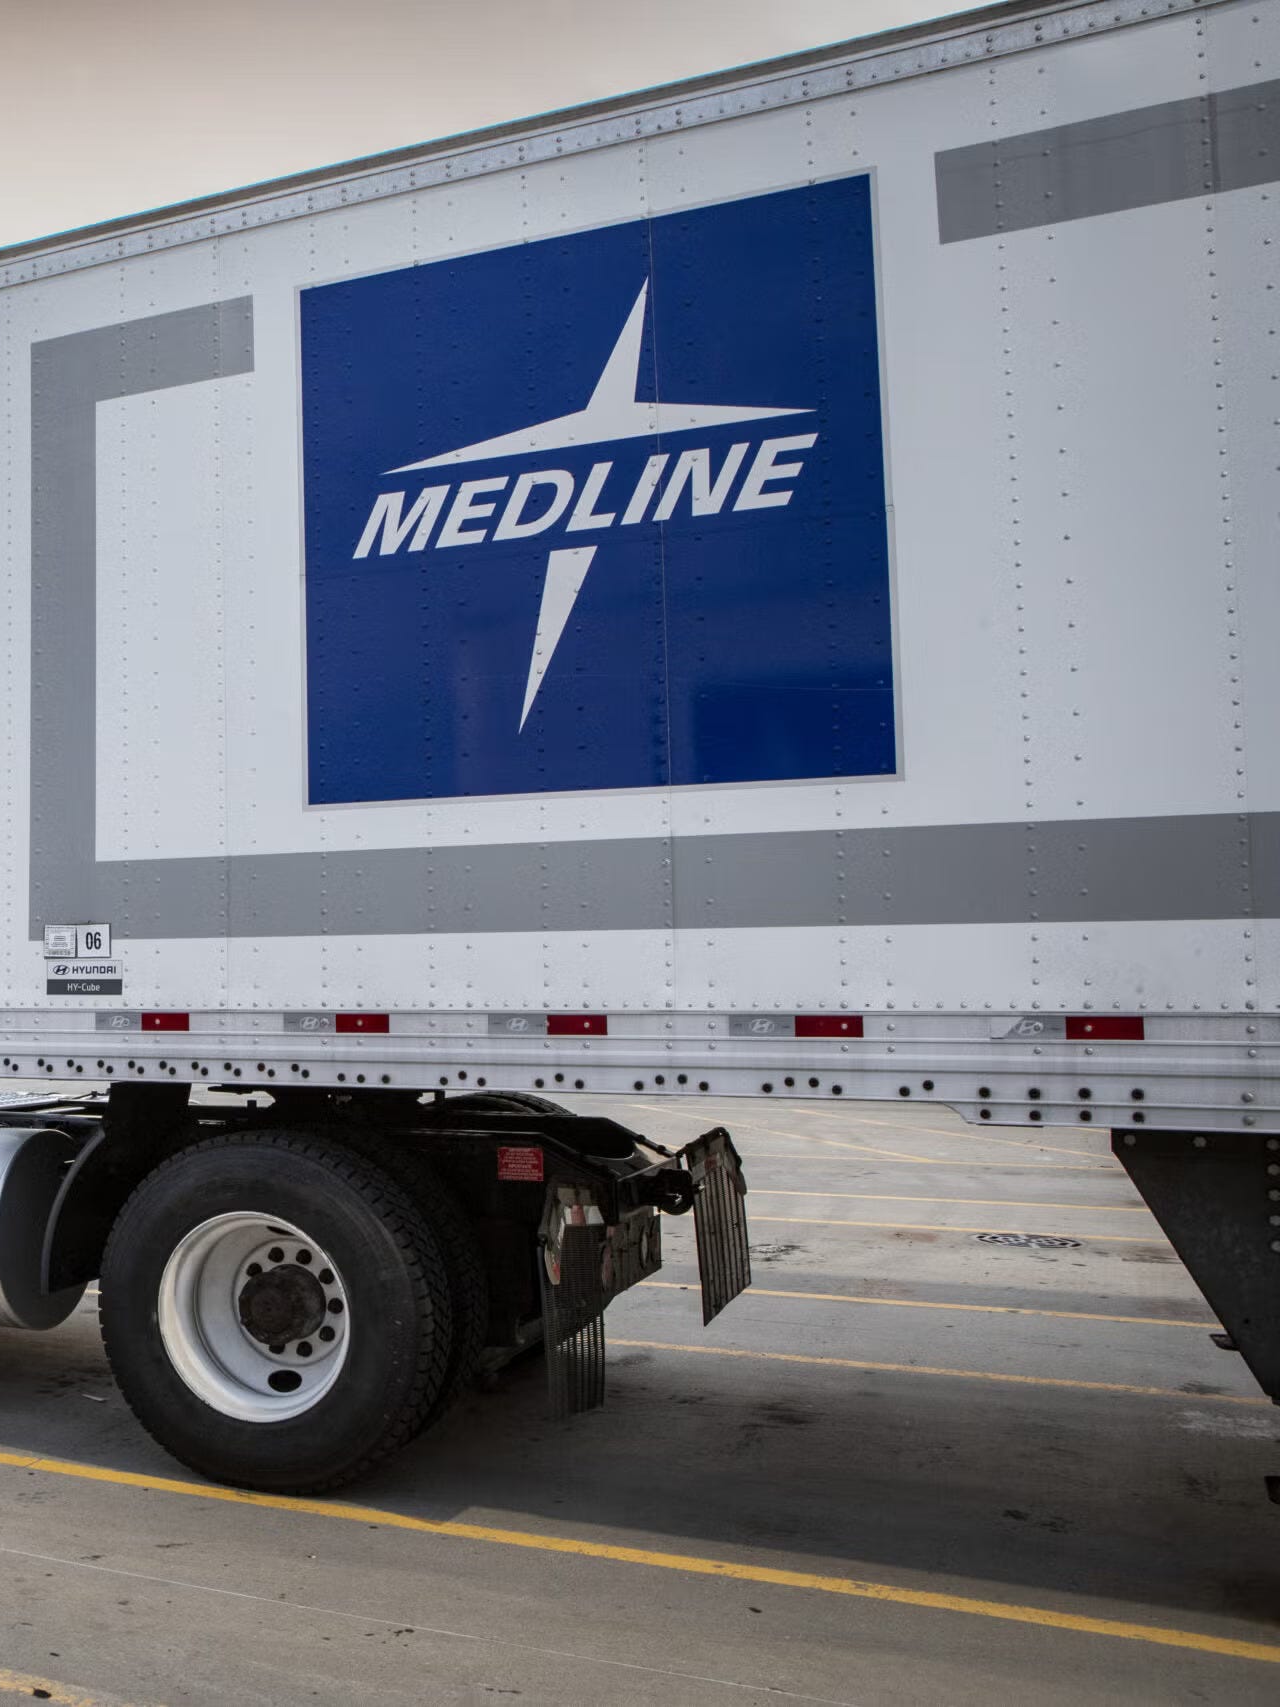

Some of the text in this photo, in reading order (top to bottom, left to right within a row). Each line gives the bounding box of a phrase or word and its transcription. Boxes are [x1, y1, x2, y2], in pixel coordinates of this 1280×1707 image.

[353, 433, 818, 559] MEDLINE
[85, 932, 102, 950] 06
[72, 966, 116, 974] HYUNDAI
[67, 983, 101, 992] HY-Cube
